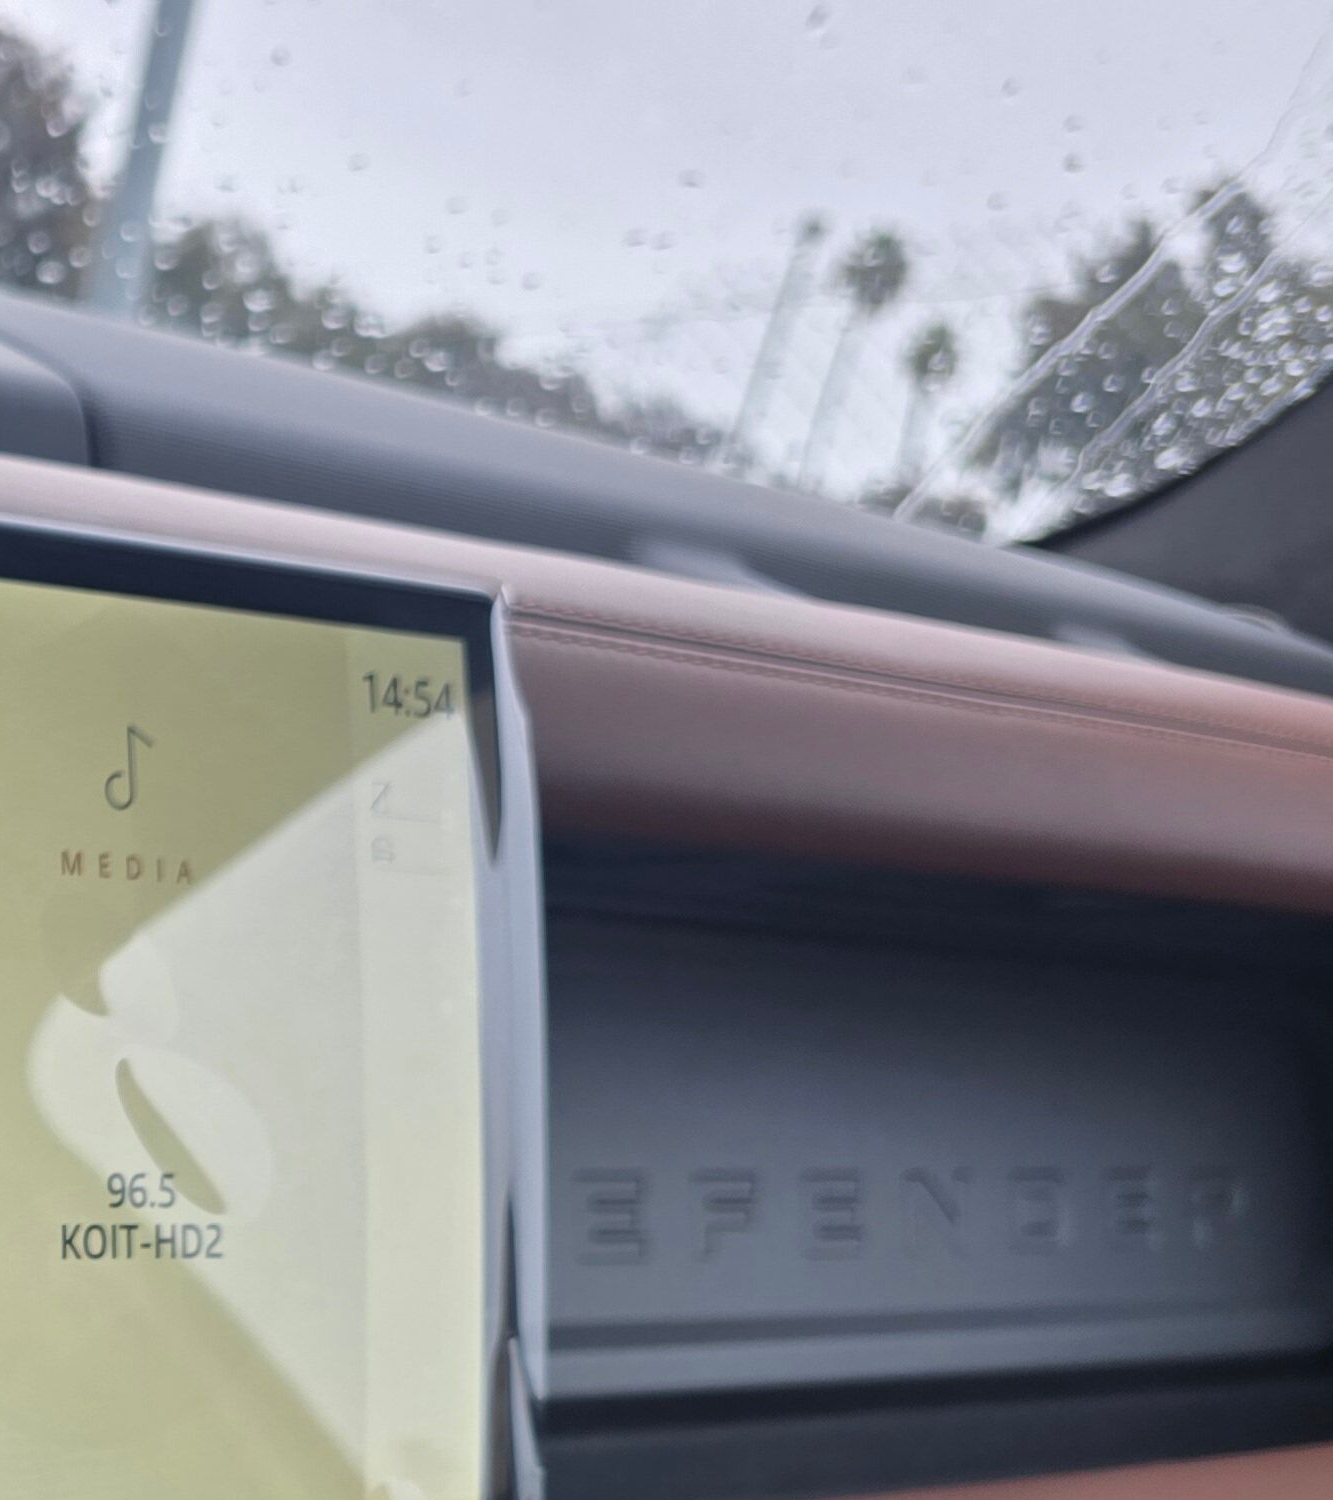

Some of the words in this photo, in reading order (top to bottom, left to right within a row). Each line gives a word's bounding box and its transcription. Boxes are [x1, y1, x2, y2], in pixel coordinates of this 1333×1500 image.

[362, 671, 457, 719] 14:54
[60, 850, 193, 884] MEDIA
[107, 1172, 176, 1208] 96.5
[61, 1224, 224, 1259] KOIT-HD2
